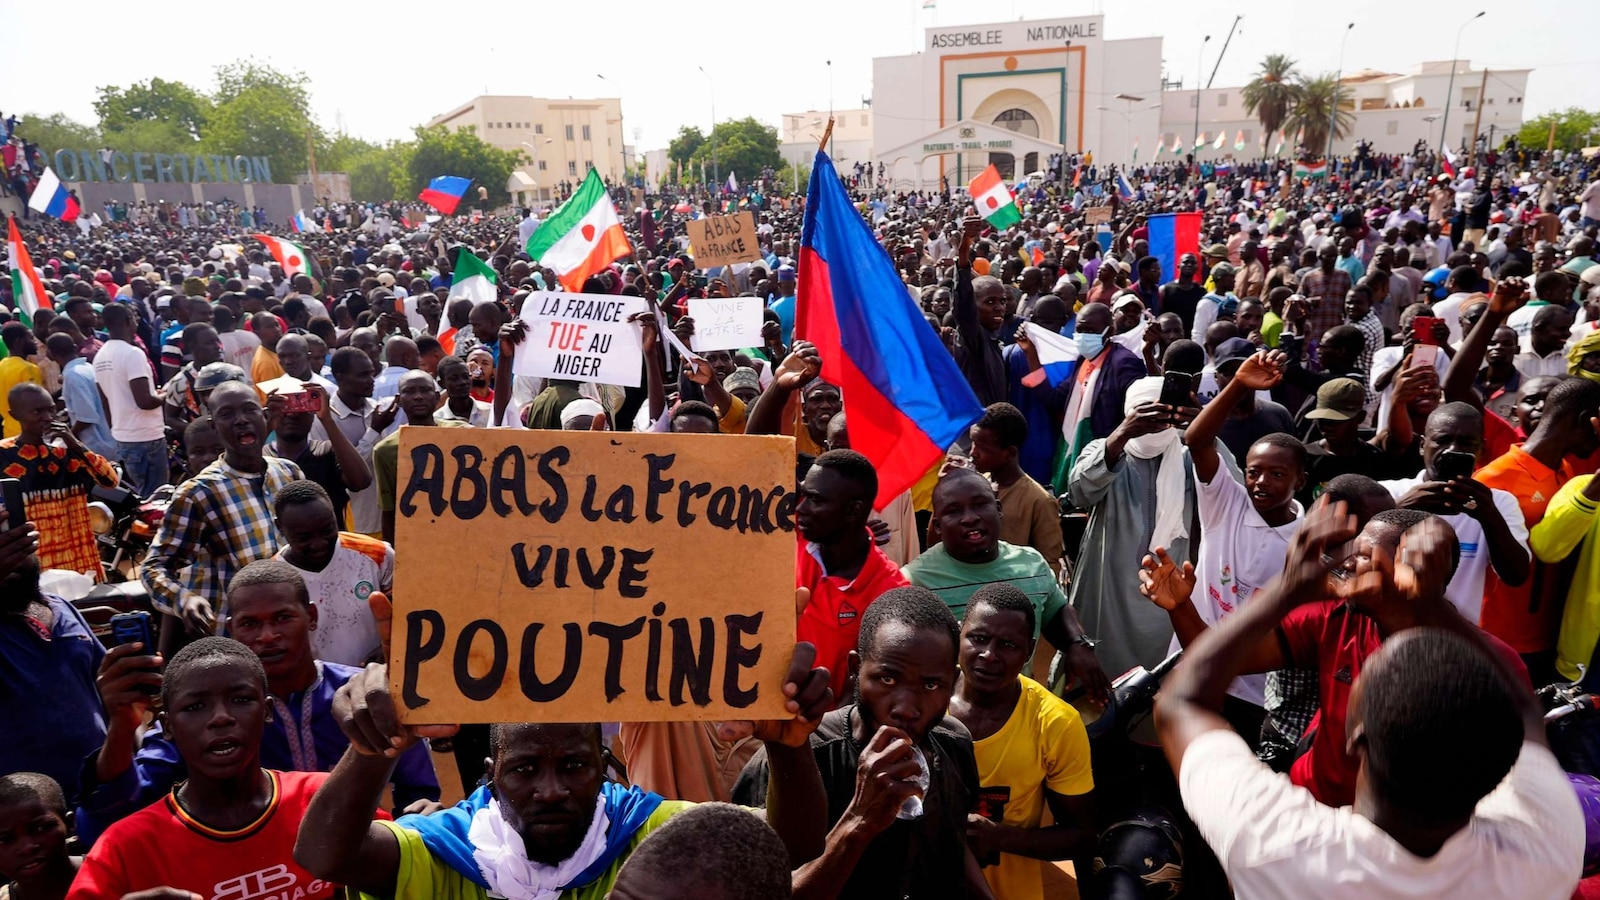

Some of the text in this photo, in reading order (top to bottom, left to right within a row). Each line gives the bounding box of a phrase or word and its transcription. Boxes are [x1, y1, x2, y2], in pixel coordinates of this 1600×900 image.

[931, 22, 1097, 49] ASSEMBLEE NATIONALE
[704, 214, 741, 241] ABAS
[694, 237, 746, 259] LA FRANCE
[539, 297, 625, 322] LA FRANCE
[547, 321, 612, 354] TUE AU
[553, 353, 602, 377] NIGER
[399, 443, 571, 524] ABAS
[641, 453, 796, 535] France
[511, 542, 655, 598] VIVE
